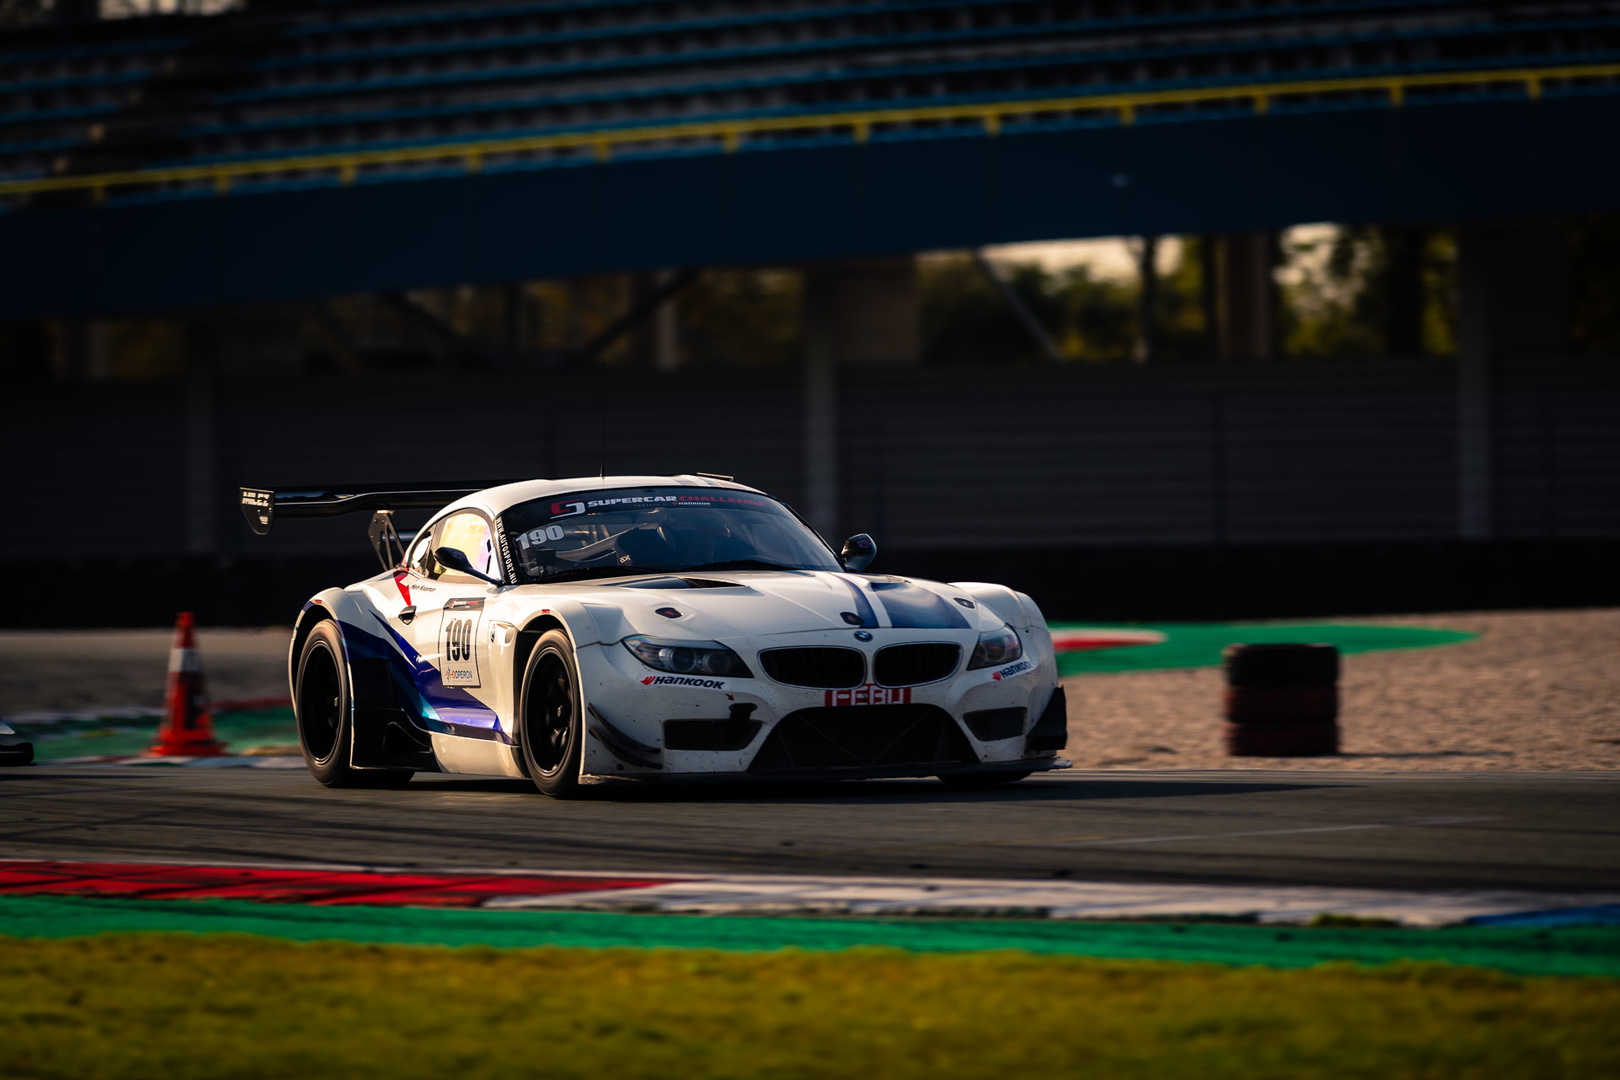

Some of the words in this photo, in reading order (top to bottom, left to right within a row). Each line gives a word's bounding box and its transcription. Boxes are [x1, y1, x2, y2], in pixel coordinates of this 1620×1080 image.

[587, 495, 677, 508] SUPERCAR
[679, 495, 766, 507] CHALLENGE
[496, 516, 518, 585] WWW.AUTOSPORT.NU
[516, 525, 565, 550] 190
[445, 618, 473, 662] 190
